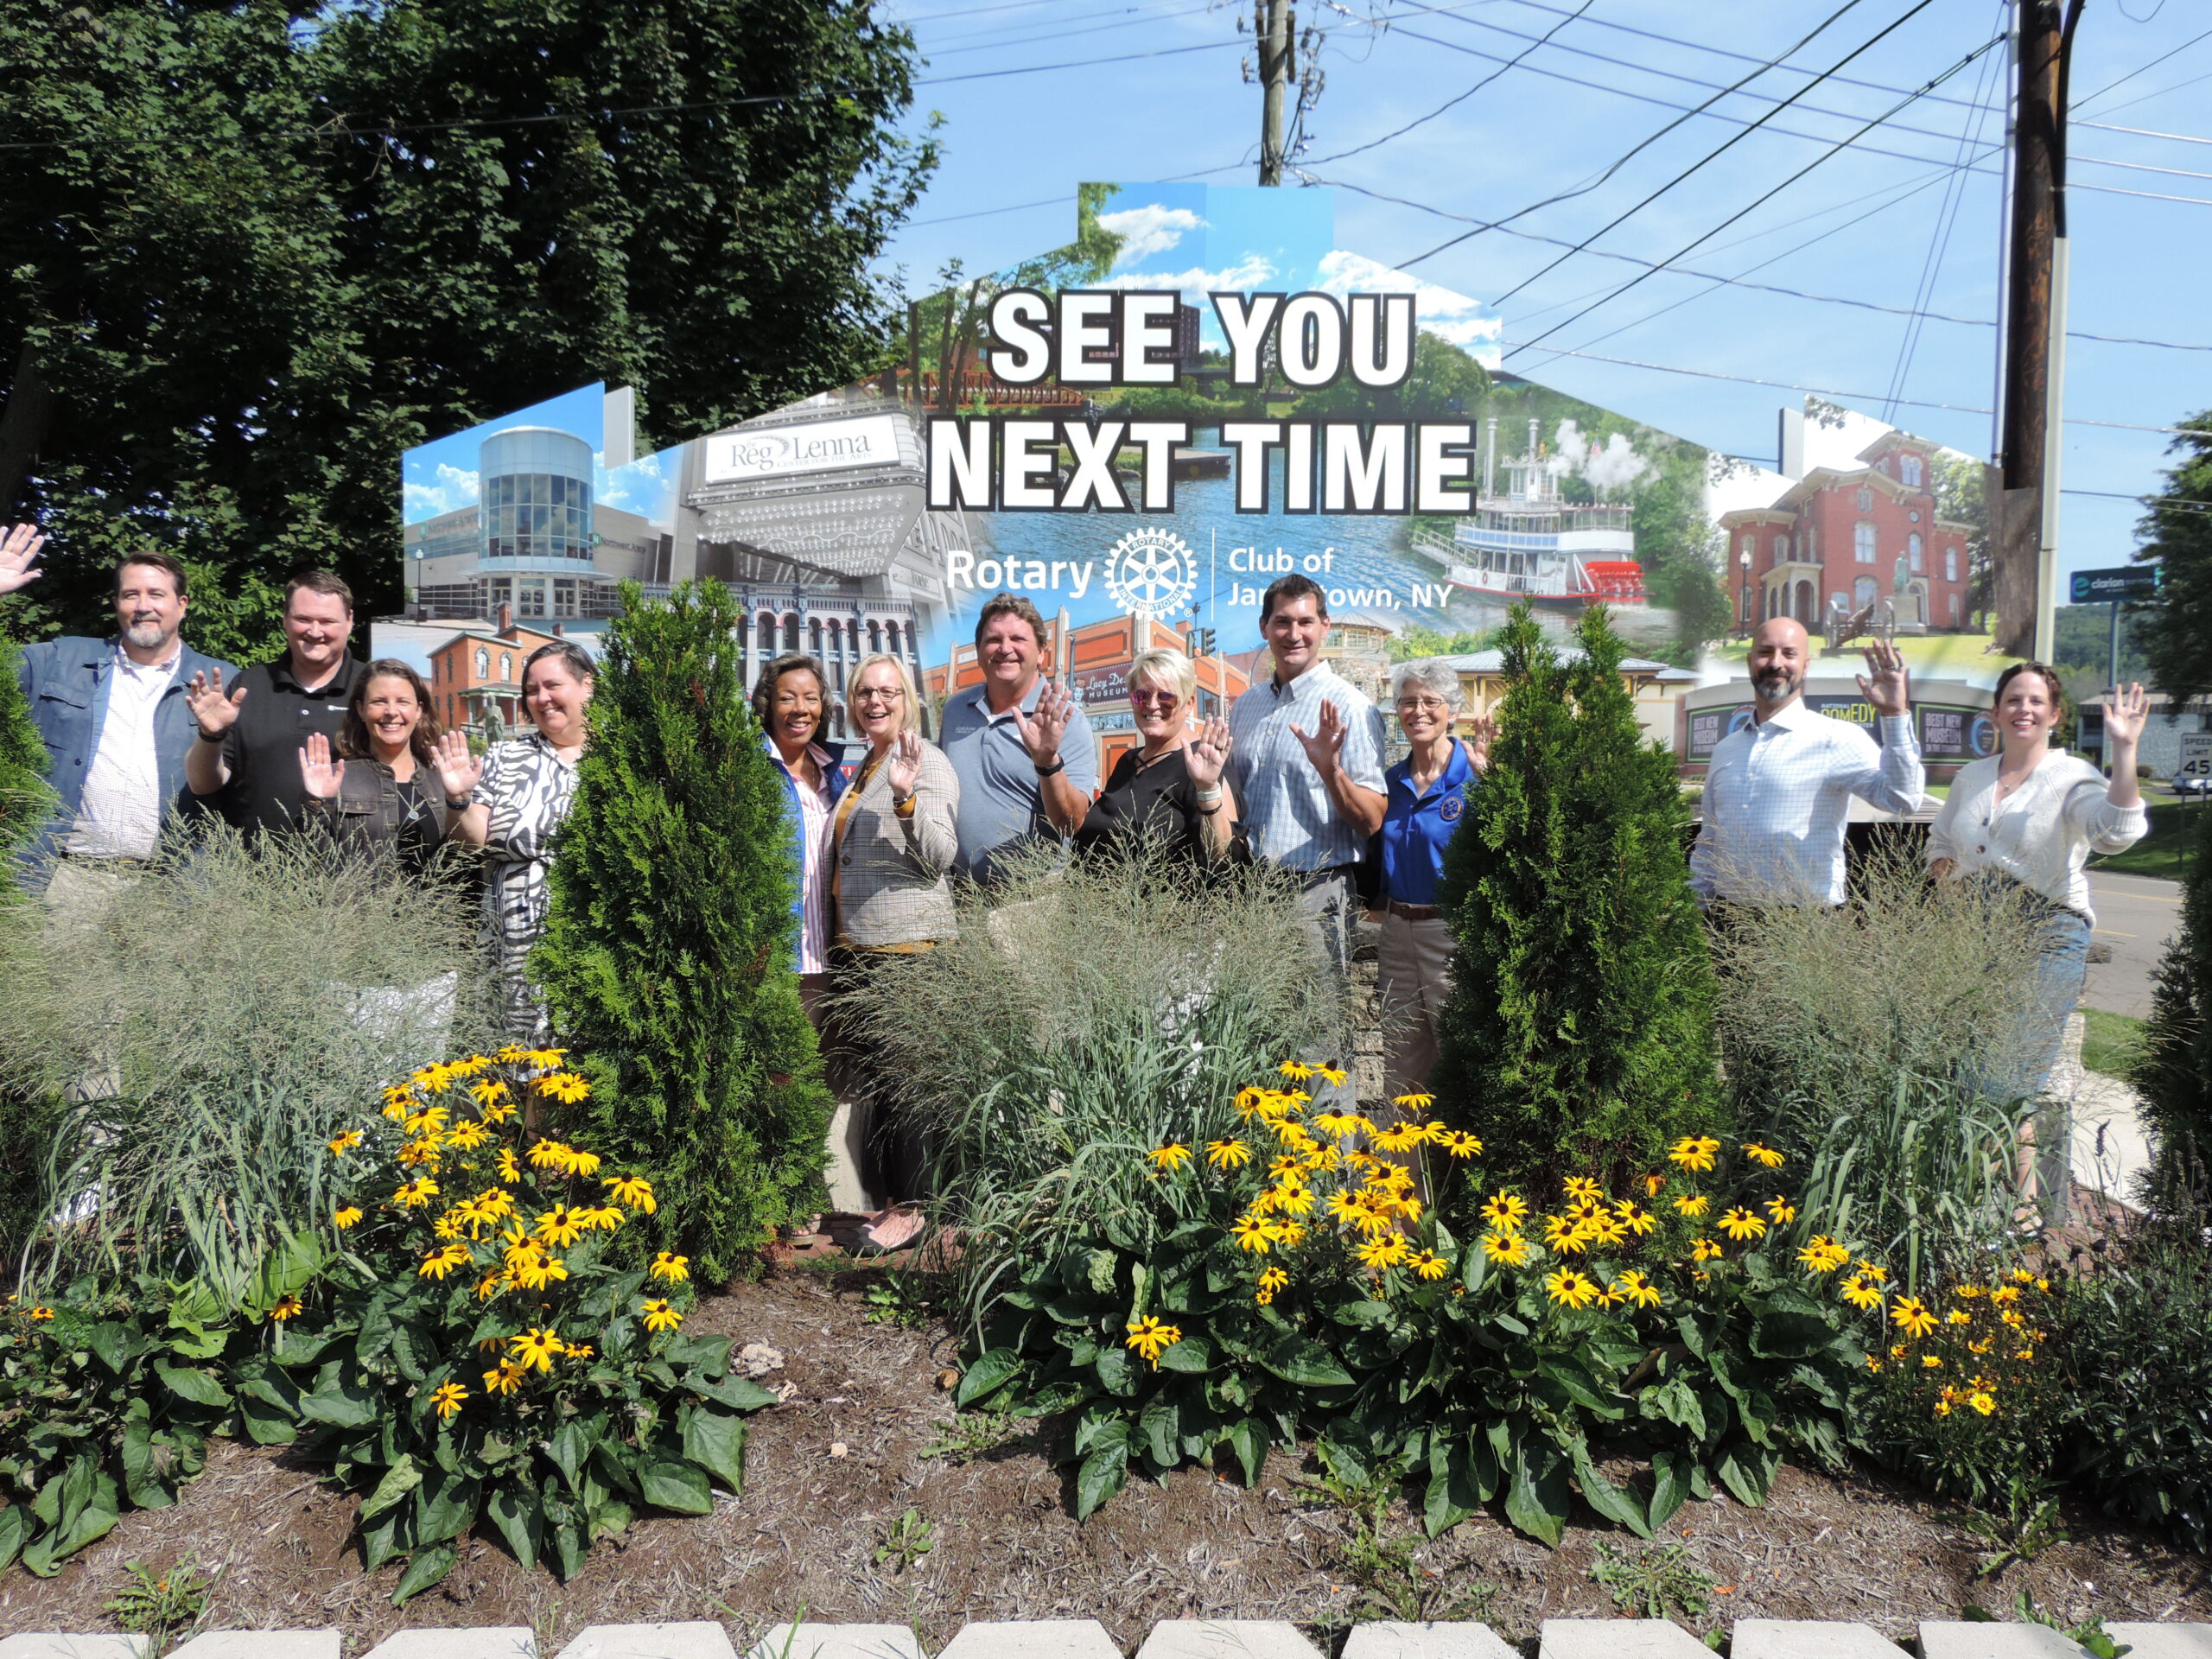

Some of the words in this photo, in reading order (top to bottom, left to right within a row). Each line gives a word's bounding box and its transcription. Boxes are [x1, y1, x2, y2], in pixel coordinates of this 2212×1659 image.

[988, 289, 1181, 388] SEE
[1208, 290, 1416, 391] YOU
[731, 443, 774, 471] Reg
[792, 435, 871, 461] Lenna
[777, 459, 810, 467] CENTER
[849, 452, 872, 461] ARTS
[926, 415, 1192, 514] NEXT
[1219, 418, 1477, 516] TIME
[1132, 537, 1172, 550] ROTARY
[1229, 547, 1293, 572] Club
[1303, 547, 1335, 573] of
[947, 550, 1093, 599] Rotary
[2091, 576, 2125, 589] clarion
[1119, 587, 1184, 612] INTERNATIONAL
[1228, 582, 1402, 611] Jatown,
[1412, 584, 1454, 608] NY
[1086, 676, 1107, 690] Lucy
[1109, 672, 1126, 686] De
[1089, 687, 1128, 698] MUSEUM
[1925, 728, 1962, 744] MUSEUM
[2183, 760, 2211, 774] 45
